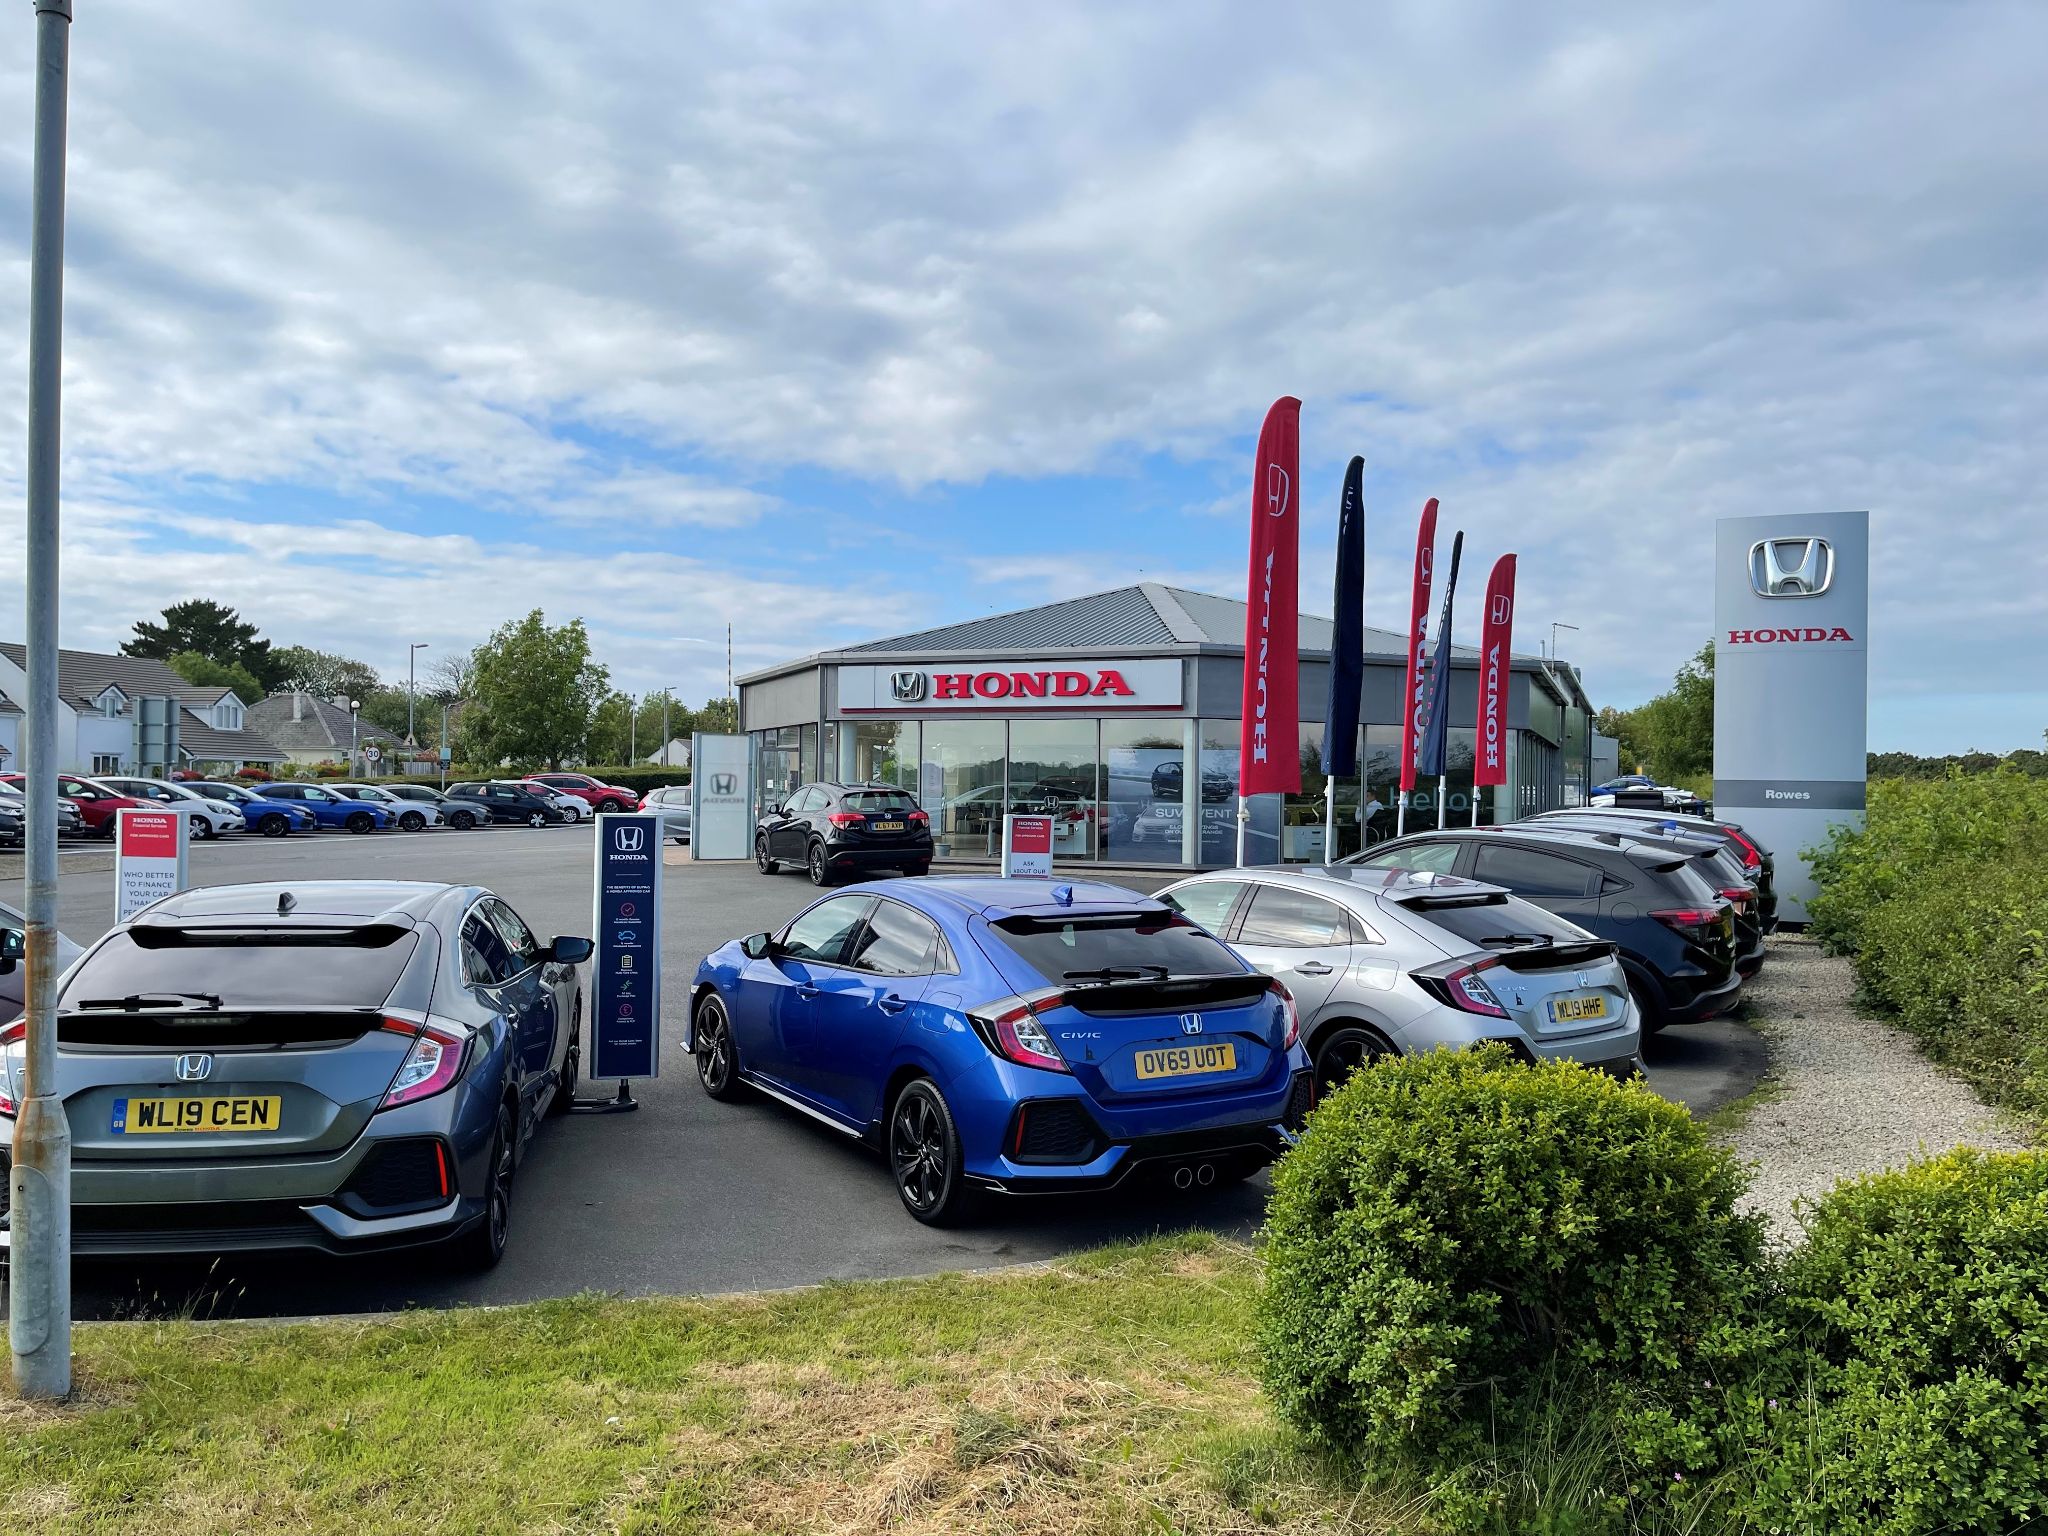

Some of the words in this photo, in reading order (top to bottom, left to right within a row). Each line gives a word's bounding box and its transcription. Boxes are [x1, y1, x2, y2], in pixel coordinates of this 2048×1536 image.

[1728, 628, 1854, 644] HONDA
[932, 670, 1135, 699] HONDA
[1486, 641, 1500, 769] HONDA
[368, 750, 379, 758] 30
[1390, 786, 1468, 811] Helo
[1765, 789, 1811, 800] Rowes
[1155, 808, 1183, 818] SUV
[1201, 808, 1233, 818] ENT
[1556, 1000, 1581, 1018] WL19
[1581, 997, 1601, 1015] HHF
[1143, 1050, 1190, 1074] OV69
[1194, 1046, 1226, 1068] UOT
[138, 1101, 203, 1127] WL19
[211, 1100, 269, 1125] CEN
